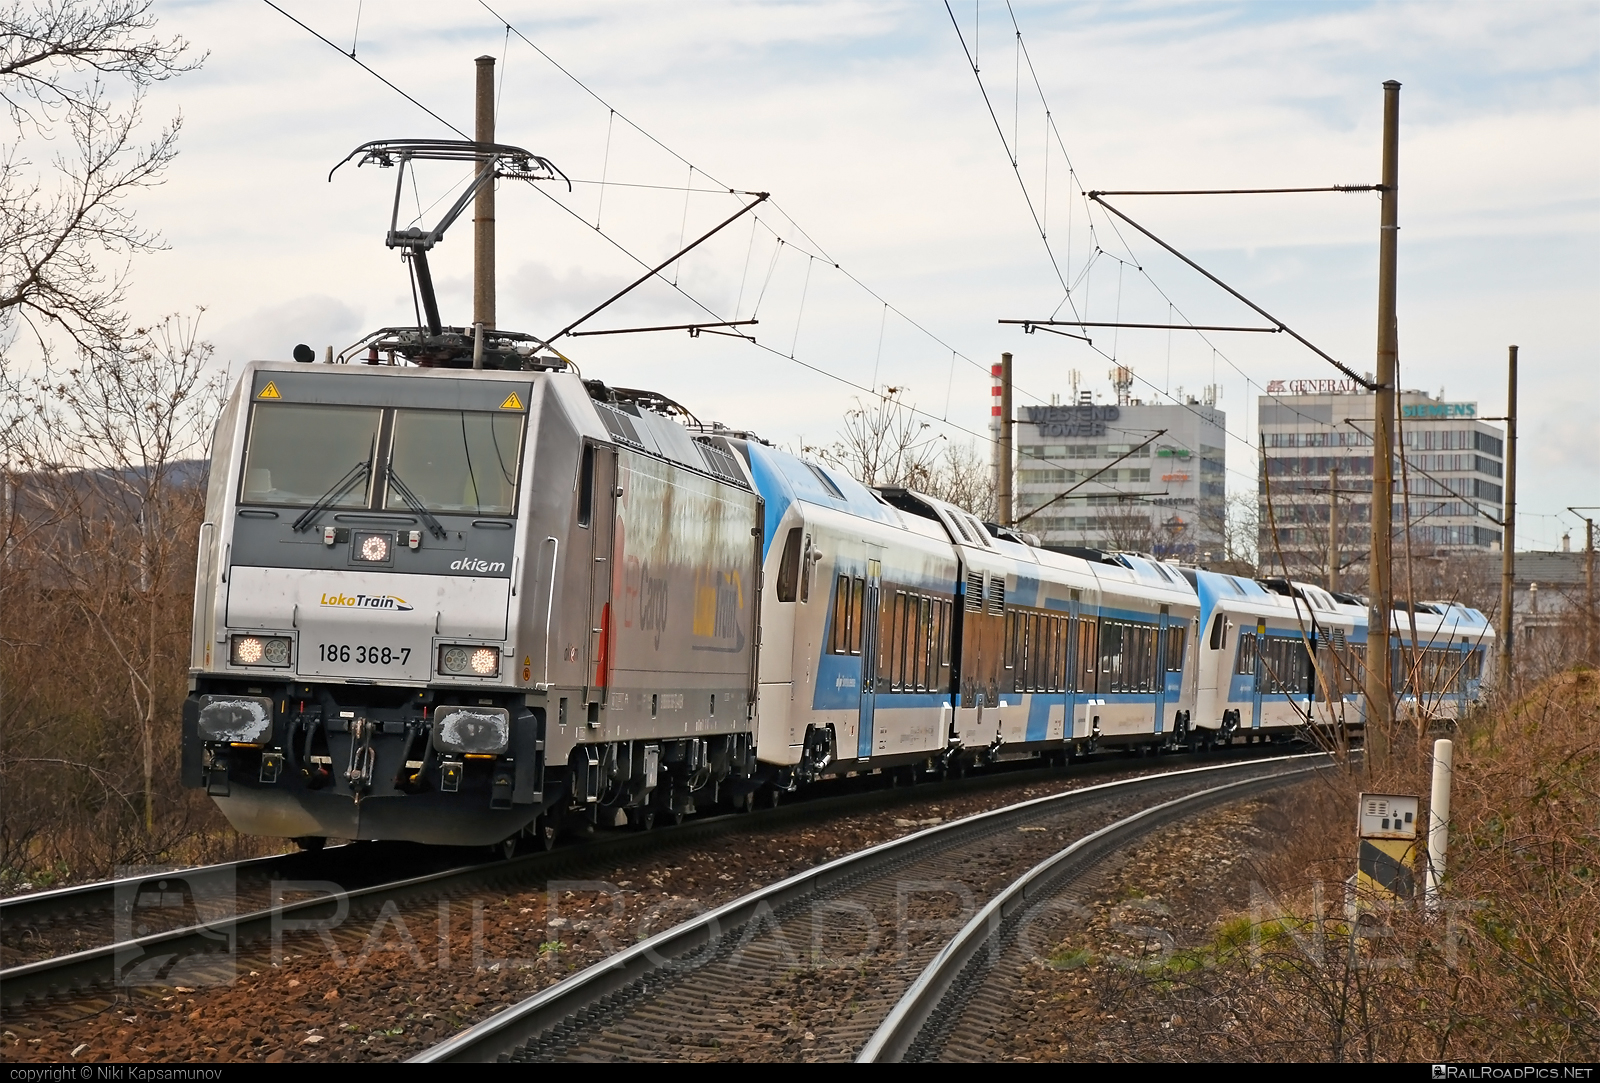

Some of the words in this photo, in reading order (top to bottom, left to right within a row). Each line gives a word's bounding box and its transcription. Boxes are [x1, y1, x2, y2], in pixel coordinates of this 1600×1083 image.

[1289, 379, 1358, 392] GENERALI
[1027, 404, 1120, 422] WESTEND
[1402, 404, 1476, 418] SIEMENS
[1036, 421, 1108, 438] TOWER
[450, 557, 506, 573] akiem
[320, 592, 395, 608] LokoTrain
[639, 556, 668, 652] Cargo
[318, 643, 351, 663] 186
[355, 646, 412, 666] 368-7
